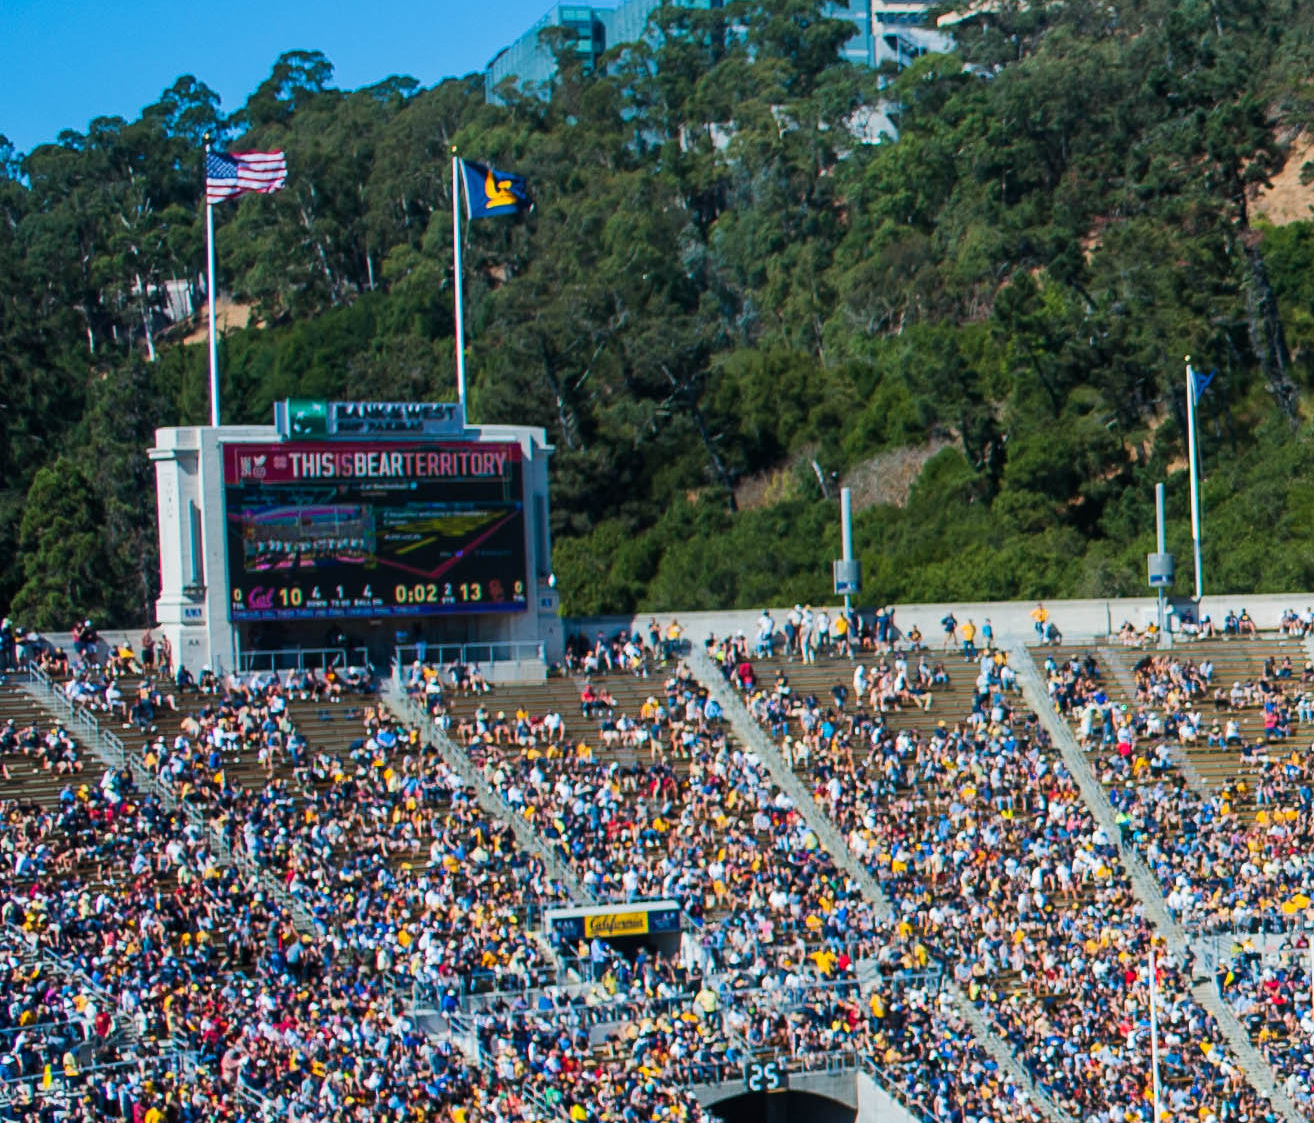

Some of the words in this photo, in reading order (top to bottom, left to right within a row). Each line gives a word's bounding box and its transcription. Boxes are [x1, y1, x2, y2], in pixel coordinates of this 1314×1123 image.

[279, 588, 302, 606] 10
[395, 584, 437, 603] 0:02
[460, 583, 482, 600] 13
[750, 1063, 779, 1091] 25
